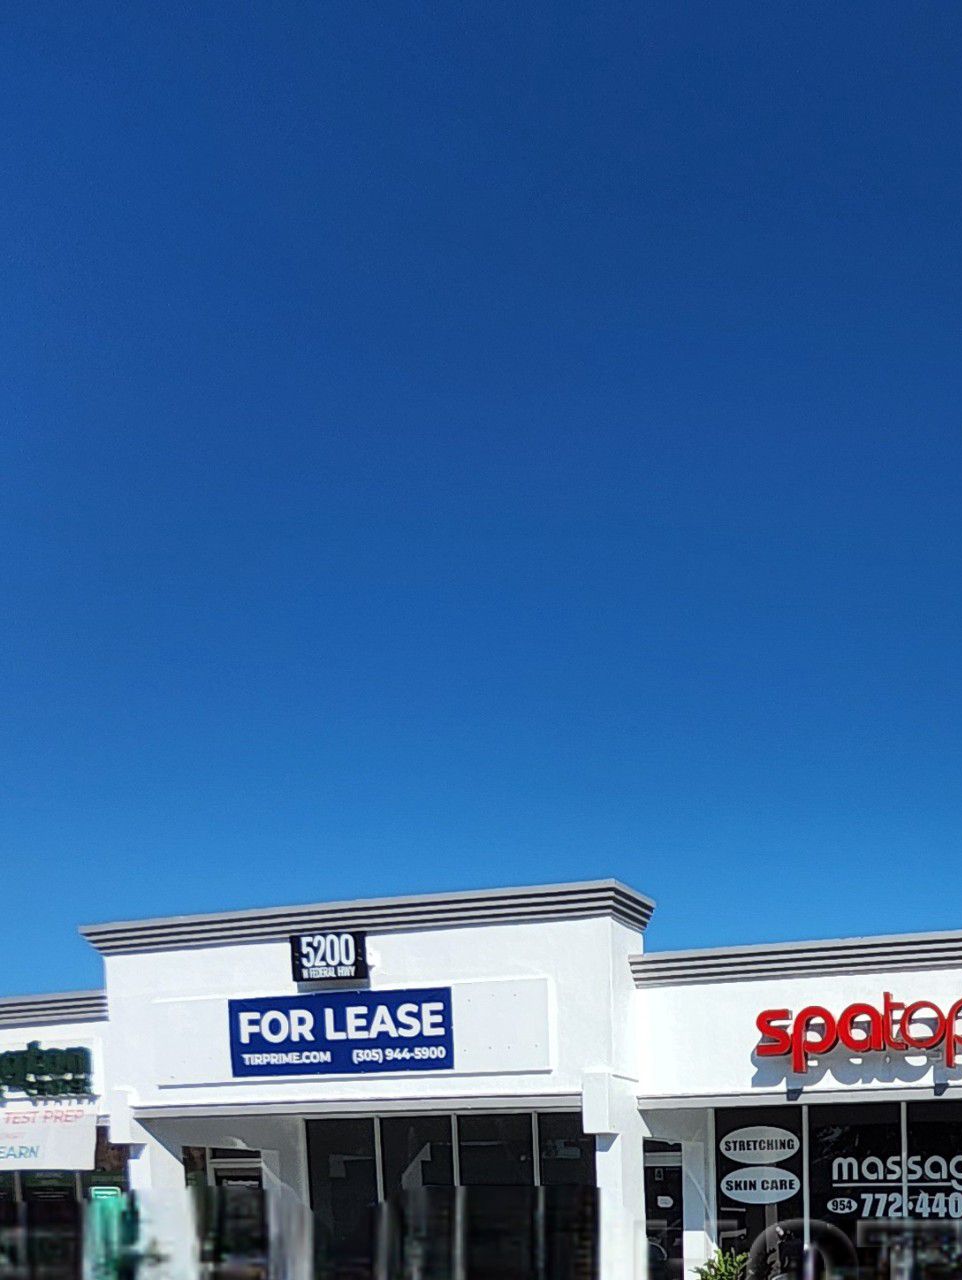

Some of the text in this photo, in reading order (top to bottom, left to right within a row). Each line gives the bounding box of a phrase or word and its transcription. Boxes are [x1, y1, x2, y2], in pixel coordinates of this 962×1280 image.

[301, 934, 355, 967] 5200
[310, 967, 336, 978] FEDERAL
[338, 966, 355, 976] HWY
[238, 1002, 446, 1044] FOR LEASE
[242, 1046, 446, 1066] TIRPRIME.COM (305) 944-5900
[5, 1109, 84, 1124] TEST PREP
[724, 1139, 795, 1151] STRETCHING
[725, 1179, 796, 1191] SKIN CARE
[830, 1200, 853, 1211] 954
